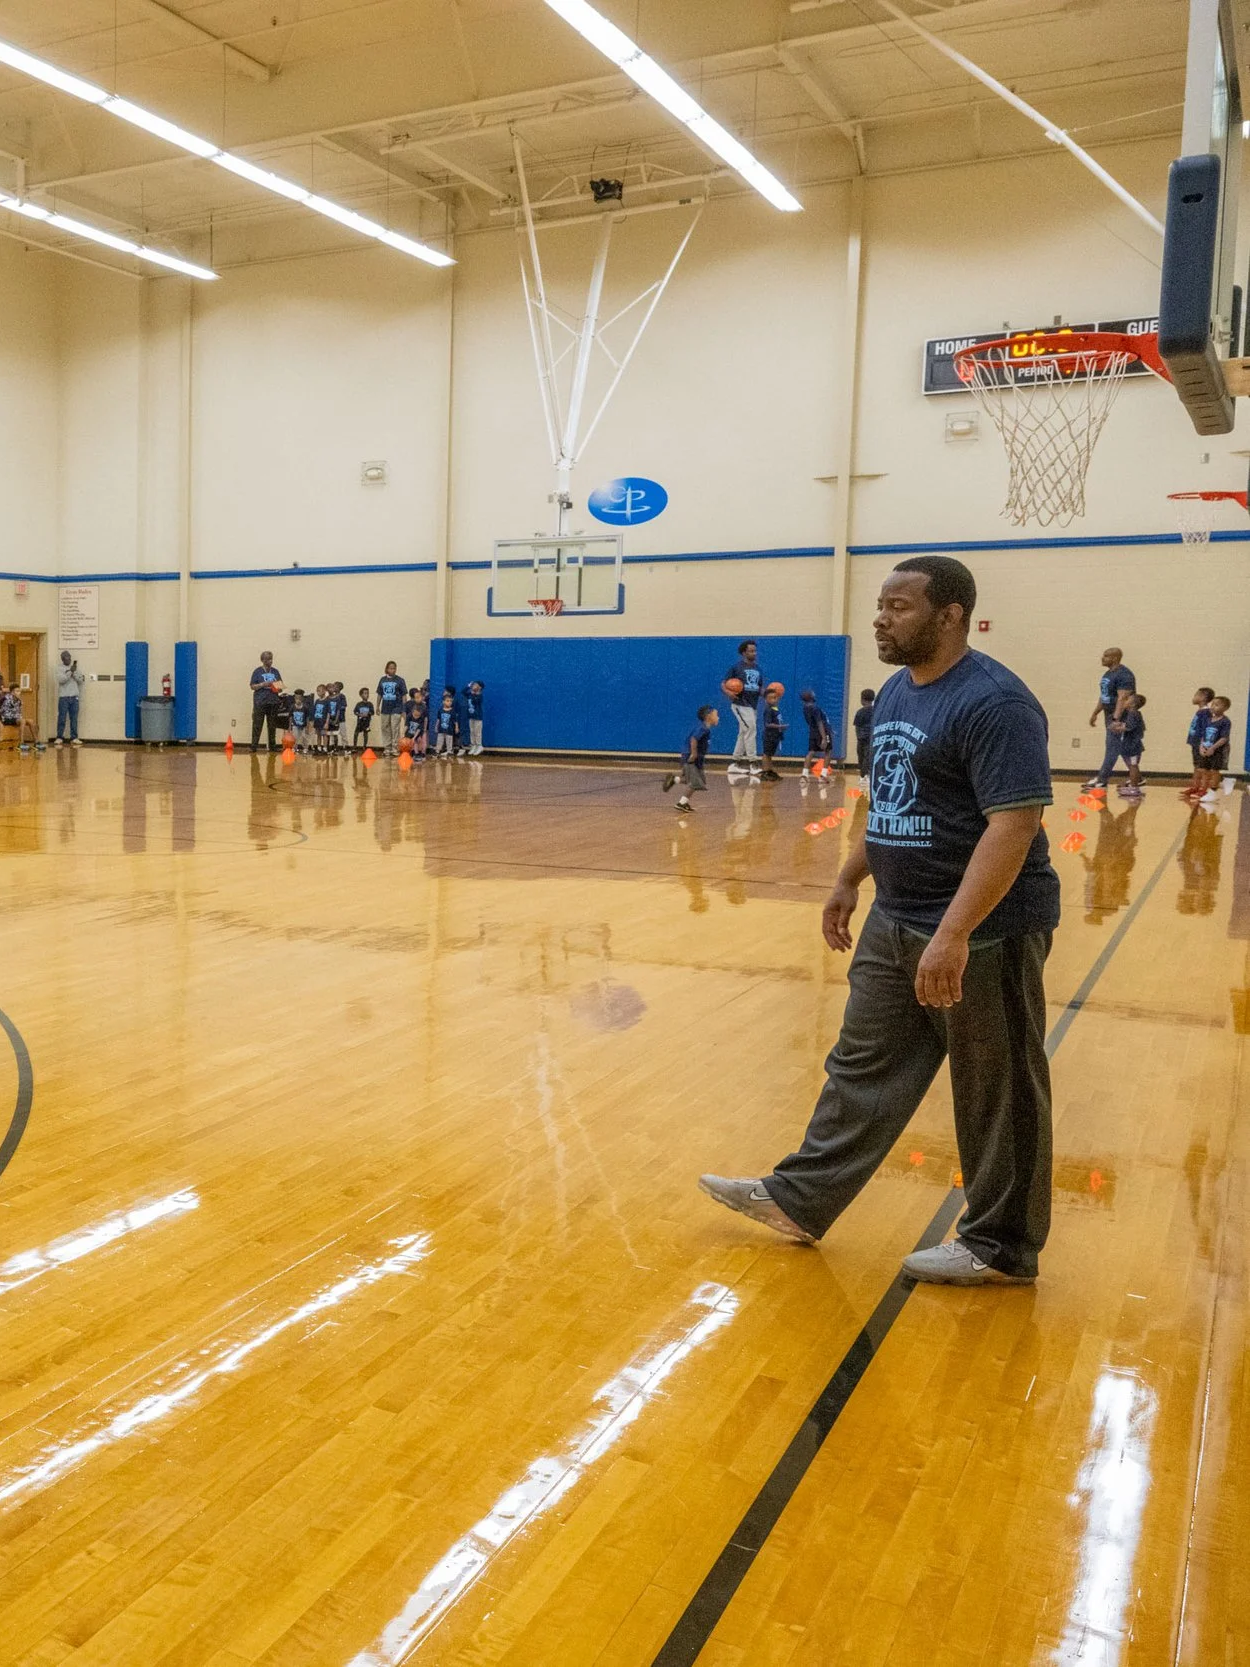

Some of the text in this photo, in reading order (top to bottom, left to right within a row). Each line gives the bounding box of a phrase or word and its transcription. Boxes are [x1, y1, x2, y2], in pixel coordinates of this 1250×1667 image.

[1126, 319, 1159, 336] GUE
[934, 339, 977, 355] HOME
[1018, 365, 1054, 377] PERIOD
